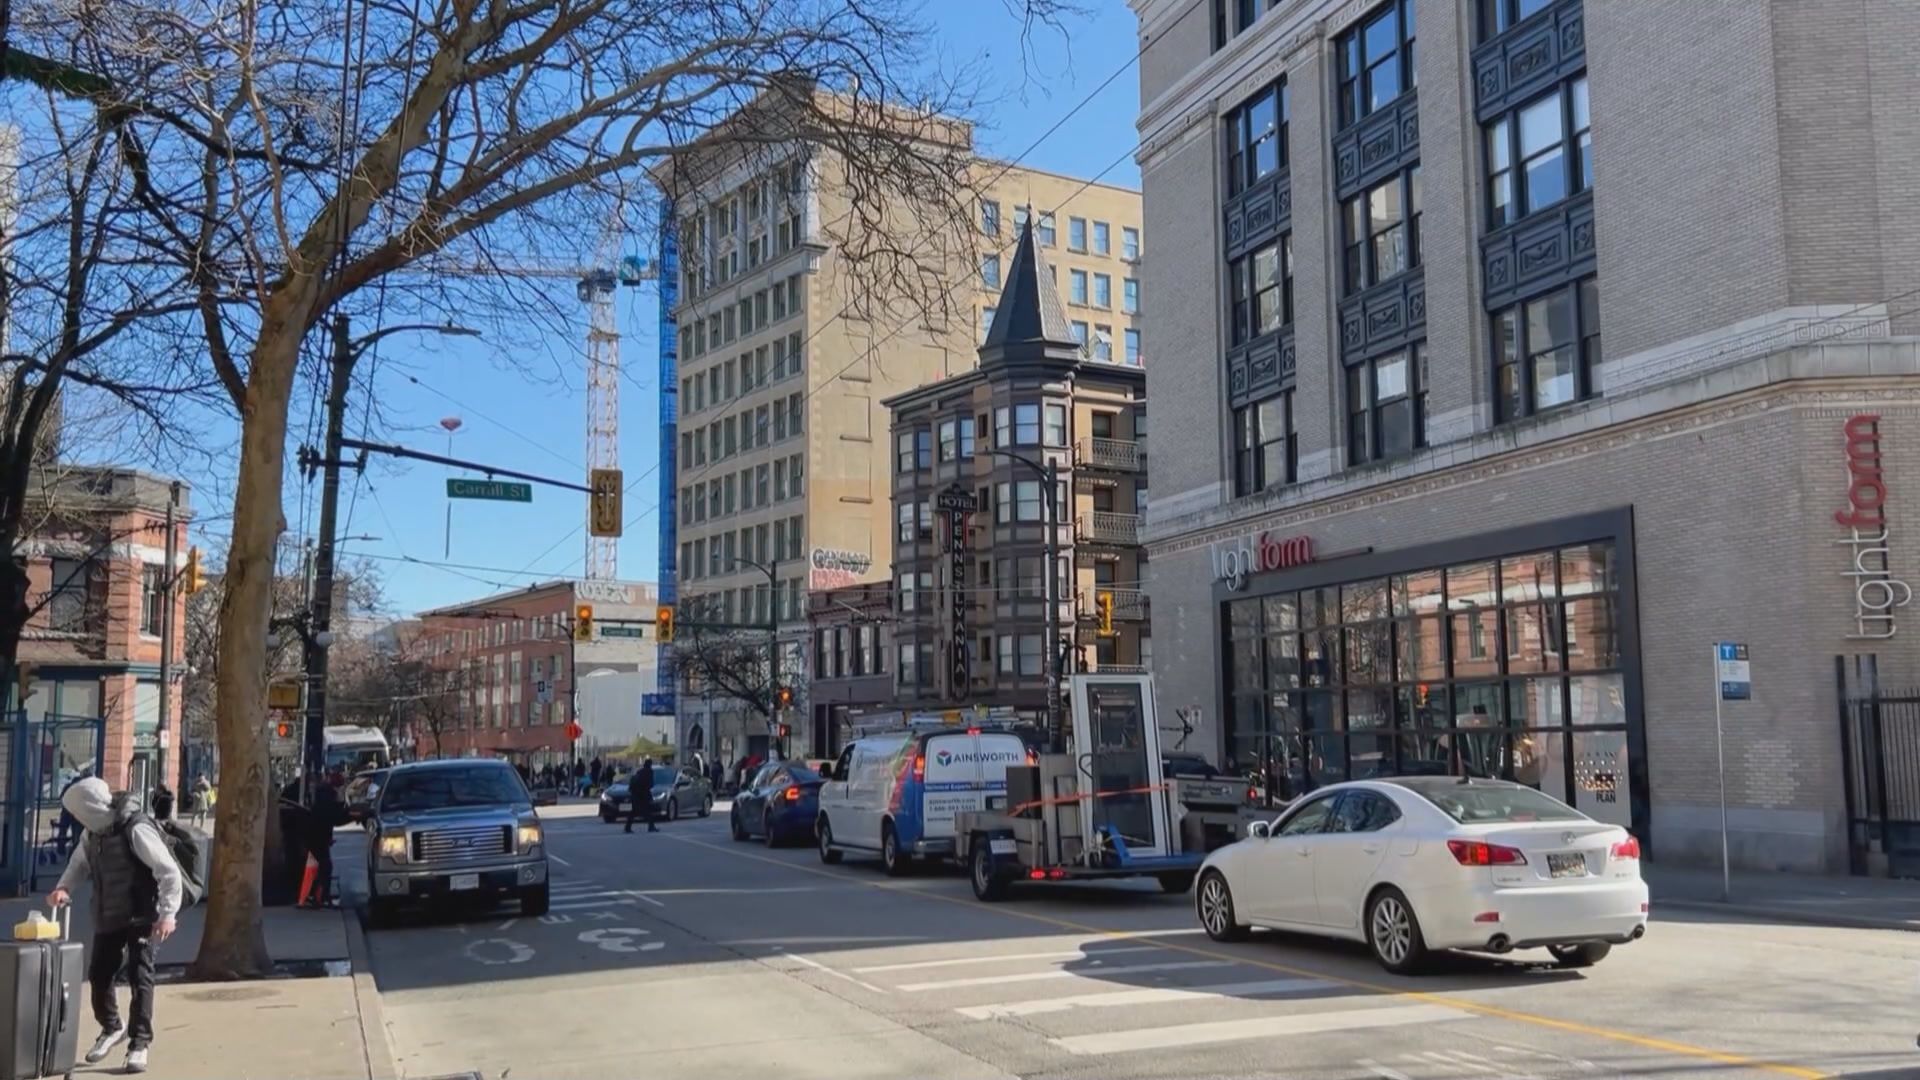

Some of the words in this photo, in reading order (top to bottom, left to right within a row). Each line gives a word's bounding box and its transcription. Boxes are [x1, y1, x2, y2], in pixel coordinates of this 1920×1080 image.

[454, 482, 503, 496] Carrall
[511, 485, 527, 497] St
[939, 494, 977, 508] HOTEL
[954, 512, 966, 673] PENNSYLVANIA
[953, 752, 1019, 763] AINSWORTH
[1596, 791, 1616, 803] PLAN
